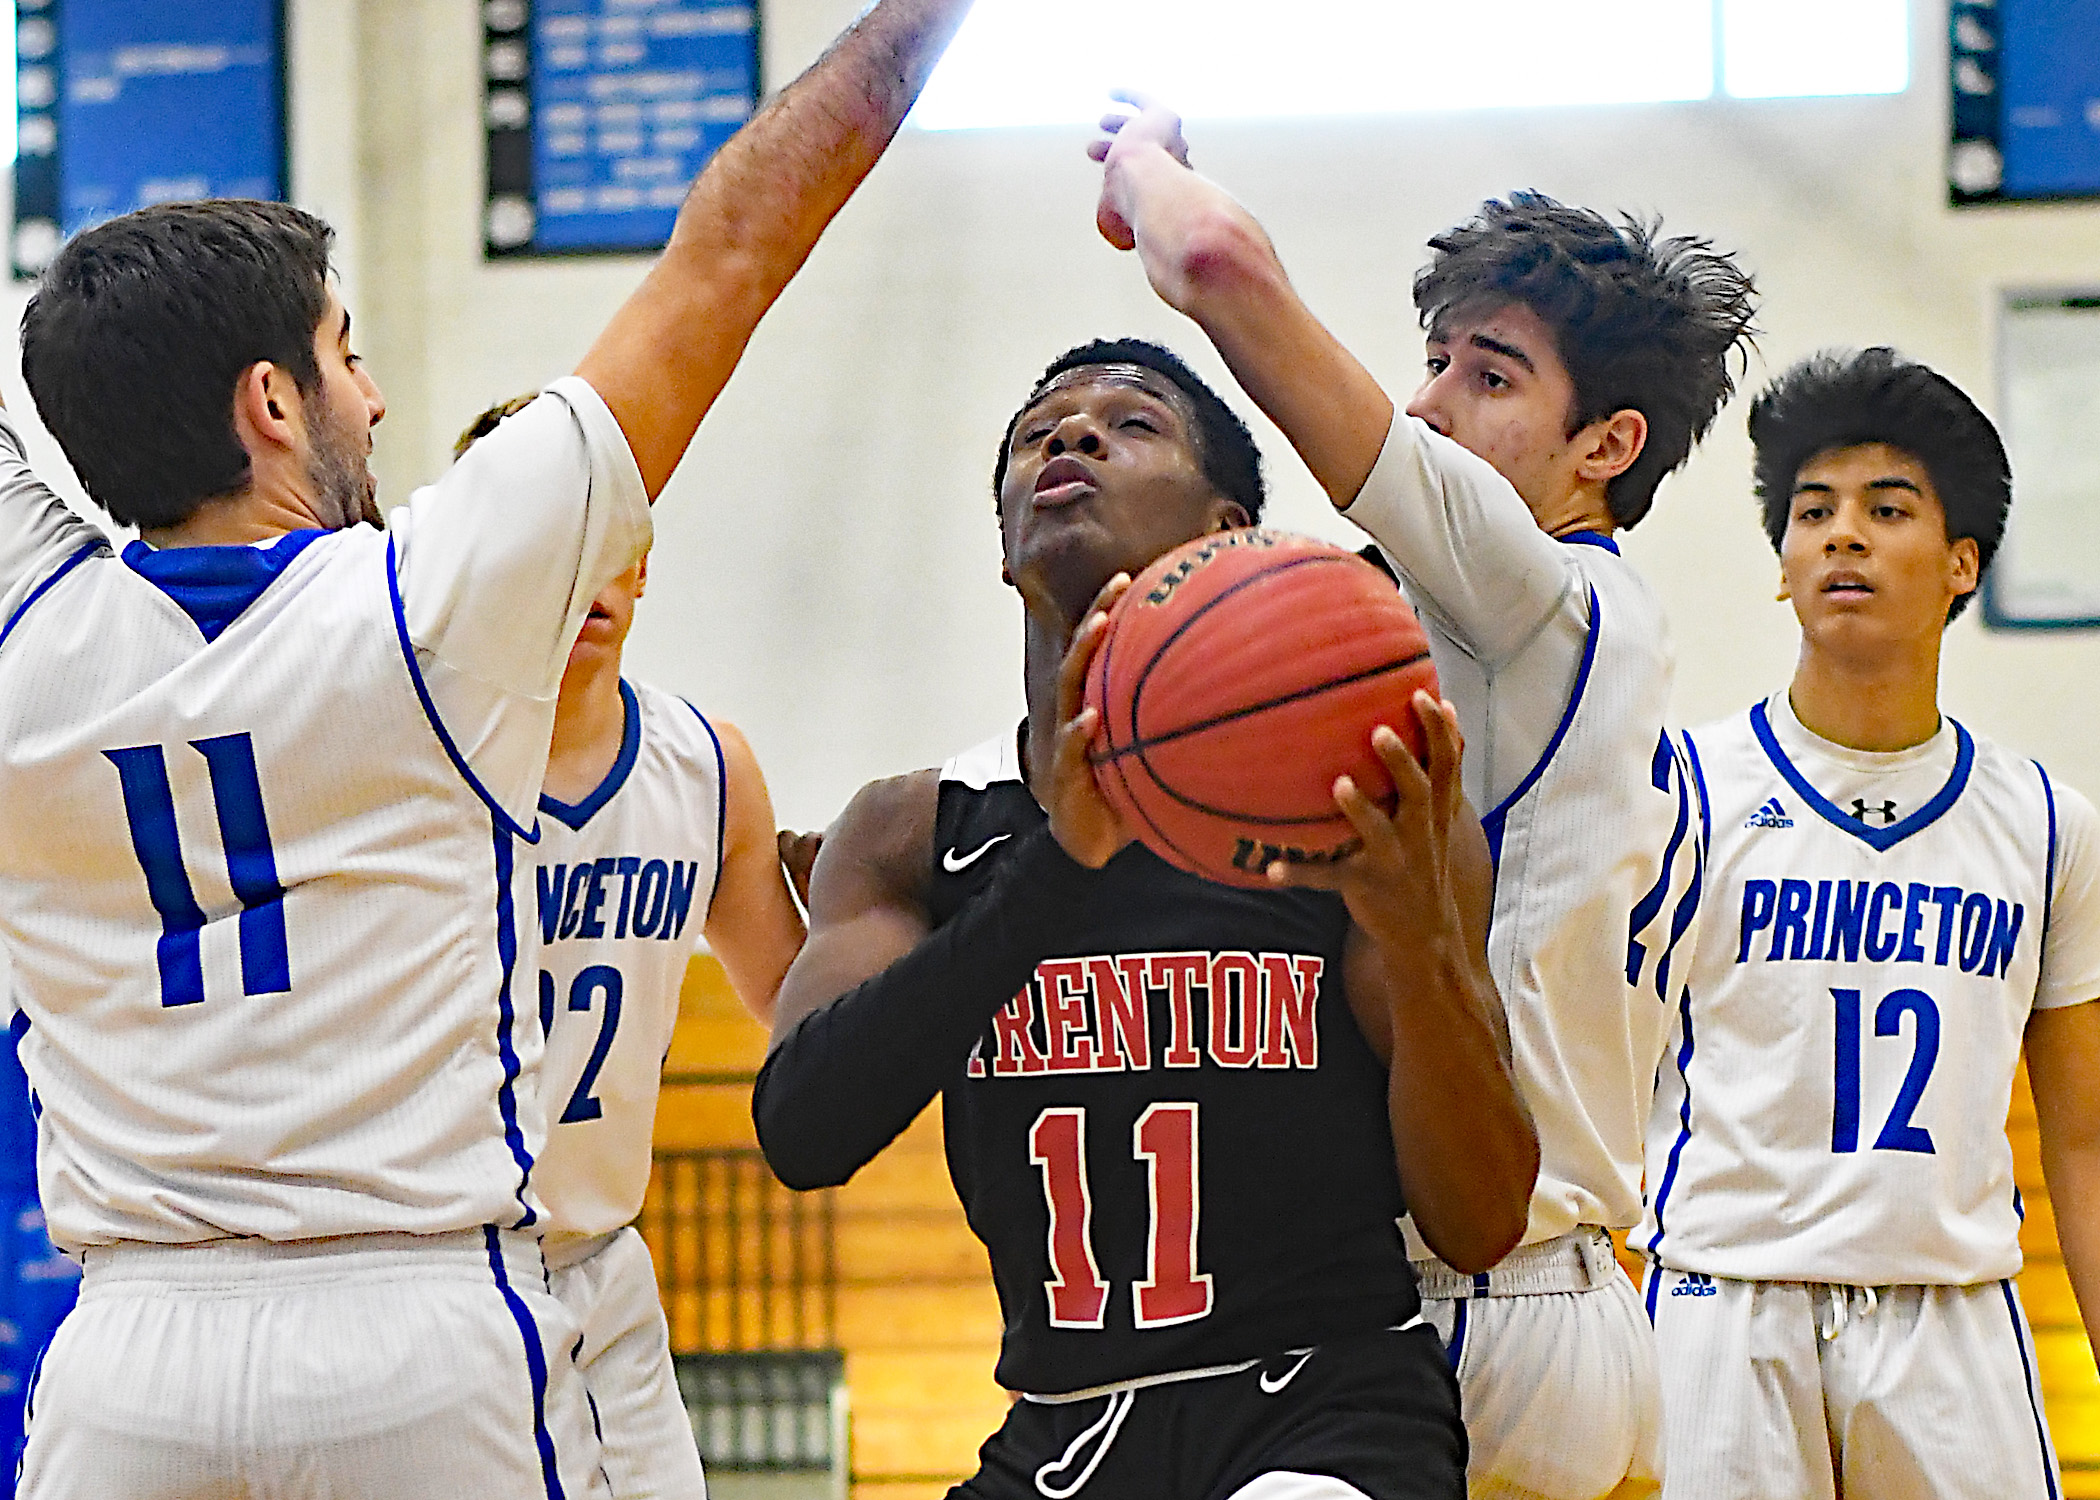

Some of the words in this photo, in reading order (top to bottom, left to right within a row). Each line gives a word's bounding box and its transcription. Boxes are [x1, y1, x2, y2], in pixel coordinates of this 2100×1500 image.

[100, 732, 291, 1007] 11
[1744, 813, 1794, 828] adidas
[1735, 879, 2024, 980] PRINCETON
[967, 951, 1324, 1077] RENTON
[1829, 988, 1940, 1154] 12
[1029, 1102, 1214, 1329] 11
[1672, 1284, 1717, 1297] adidas
